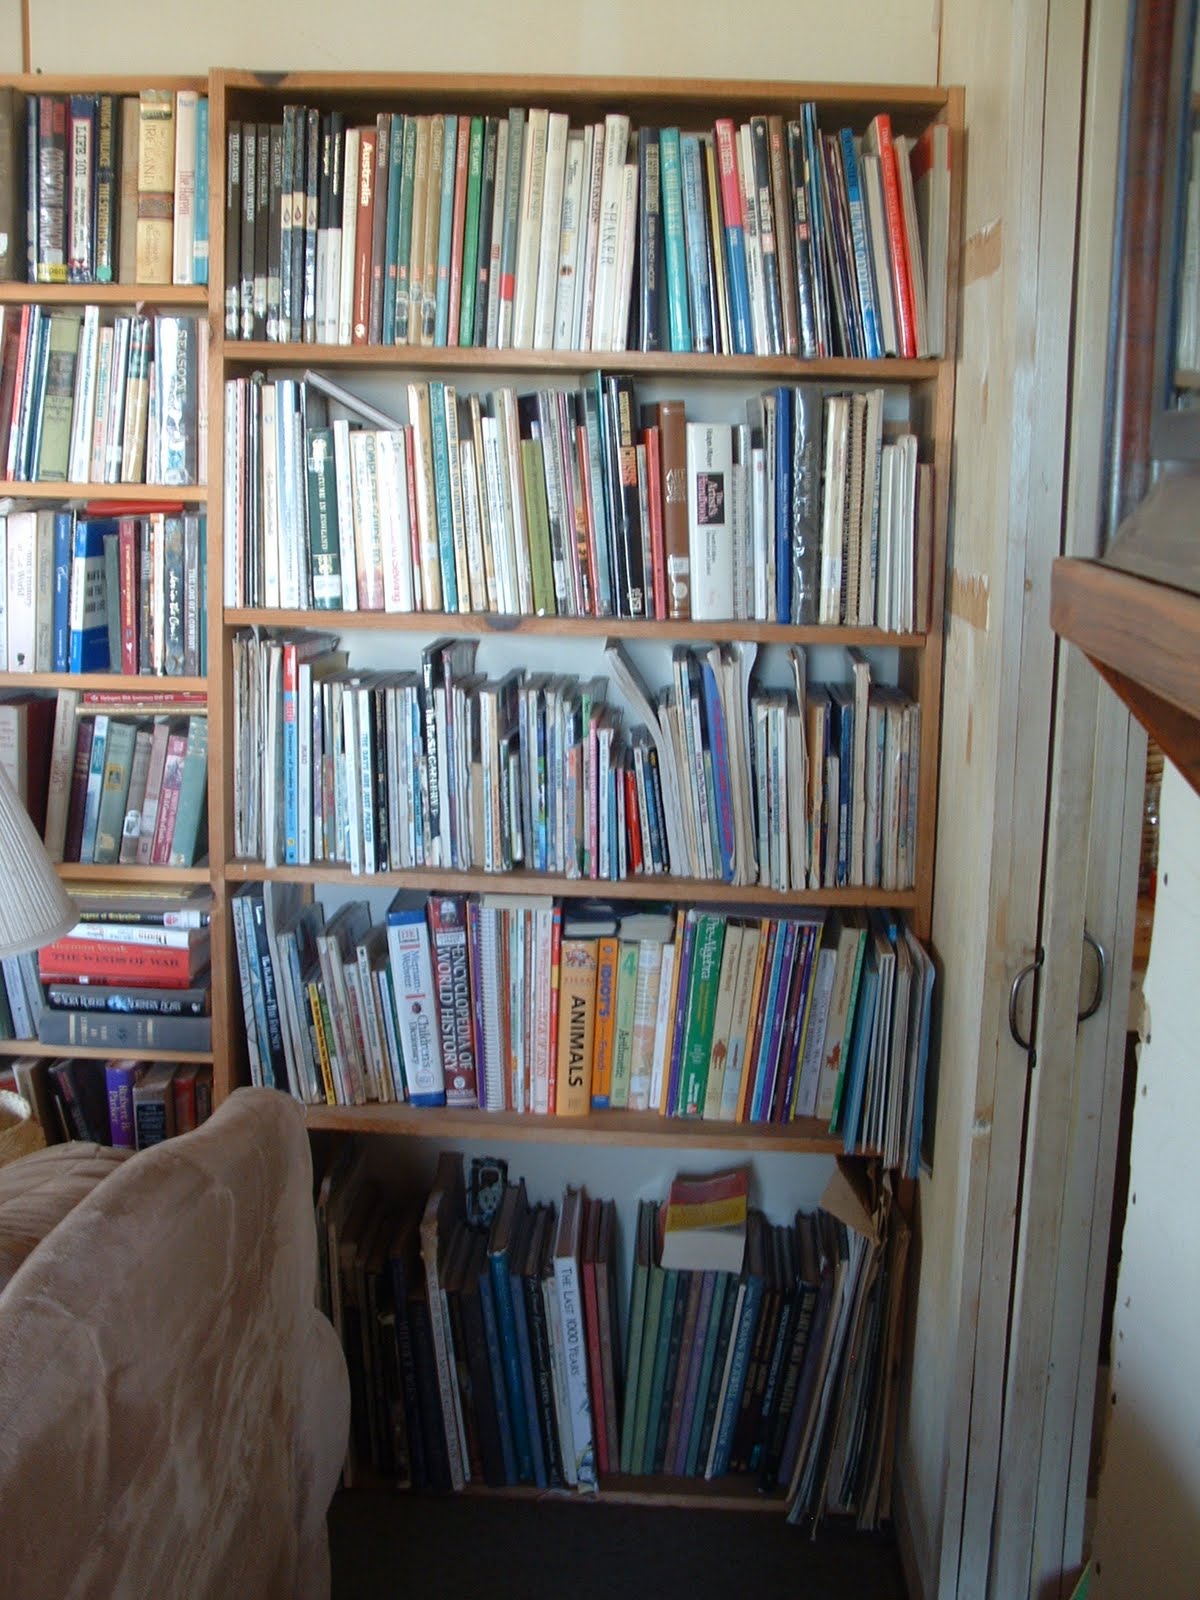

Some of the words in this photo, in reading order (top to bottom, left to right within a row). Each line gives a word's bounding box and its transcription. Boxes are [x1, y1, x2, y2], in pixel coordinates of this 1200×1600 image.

[76, 126, 86, 154] LIFE
[144, 125, 156, 184] IRELAND
[393, 129, 403, 147] THE
[472, 134, 481, 150] THE
[76, 159, 86, 176] 101
[393, 149, 402, 164] SEA
[471, 150, 480, 176] PLANTS
[180, 170, 194, 185] The
[360, 141, 373, 207] Australia
[179, 188, 194, 215] Harem
[591, 166, 601, 224] SHAKERS
[600, 200, 619, 265] SHAKER
[799, 224, 807, 240] LIFE
[318, 501, 327, 512] IN
[697, 474, 708, 524] Handbook
[707, 480, 718, 516] Artist's
[319, 513, 329, 551] ENGLAND
[16, 570, 25, 597] World
[187, 567, 196, 585] THE
[187, 584, 196, 600] LOG
[391, 559, 401, 603] Sewing
[187, 618, 196, 651] COWBOY
[363, 790, 372, 810] JUST
[53, 953, 80, 961] THE
[129, 957, 145, 965] OF
[151, 958, 179, 967] WAR
[699, 916, 721, 980] Pre-Algebra
[402, 952, 413, 988] Webster
[411, 950, 422, 994] Merriam-
[437, 945, 454, 1005] WORLD
[360, 960, 369, 975] The
[367, 1008, 374, 1016] of
[452, 947, 472, 1049] ENCYCLOPEDIA
[598, 963, 612, 1017] IDIOT'S
[408, 1021, 420, 1065] Dictionary
[415, 1014, 433, 1069] Children's
[440, 1007, 458, 1072] HISTORY
[568, 994, 586, 1088] ANIMALS
[615, 1028, 630, 1079] Arithmetic
[459, 1051, 474, 1070] OF
[109, 1090, 119, 1122] Parker
[118, 1085, 128, 1119] Robert
[560, 1267, 574, 1289] THE
[562, 1289, 577, 1317] LAST
[565, 1318, 579, 1344] 1000
[567, 1346, 581, 1377] YEARS
